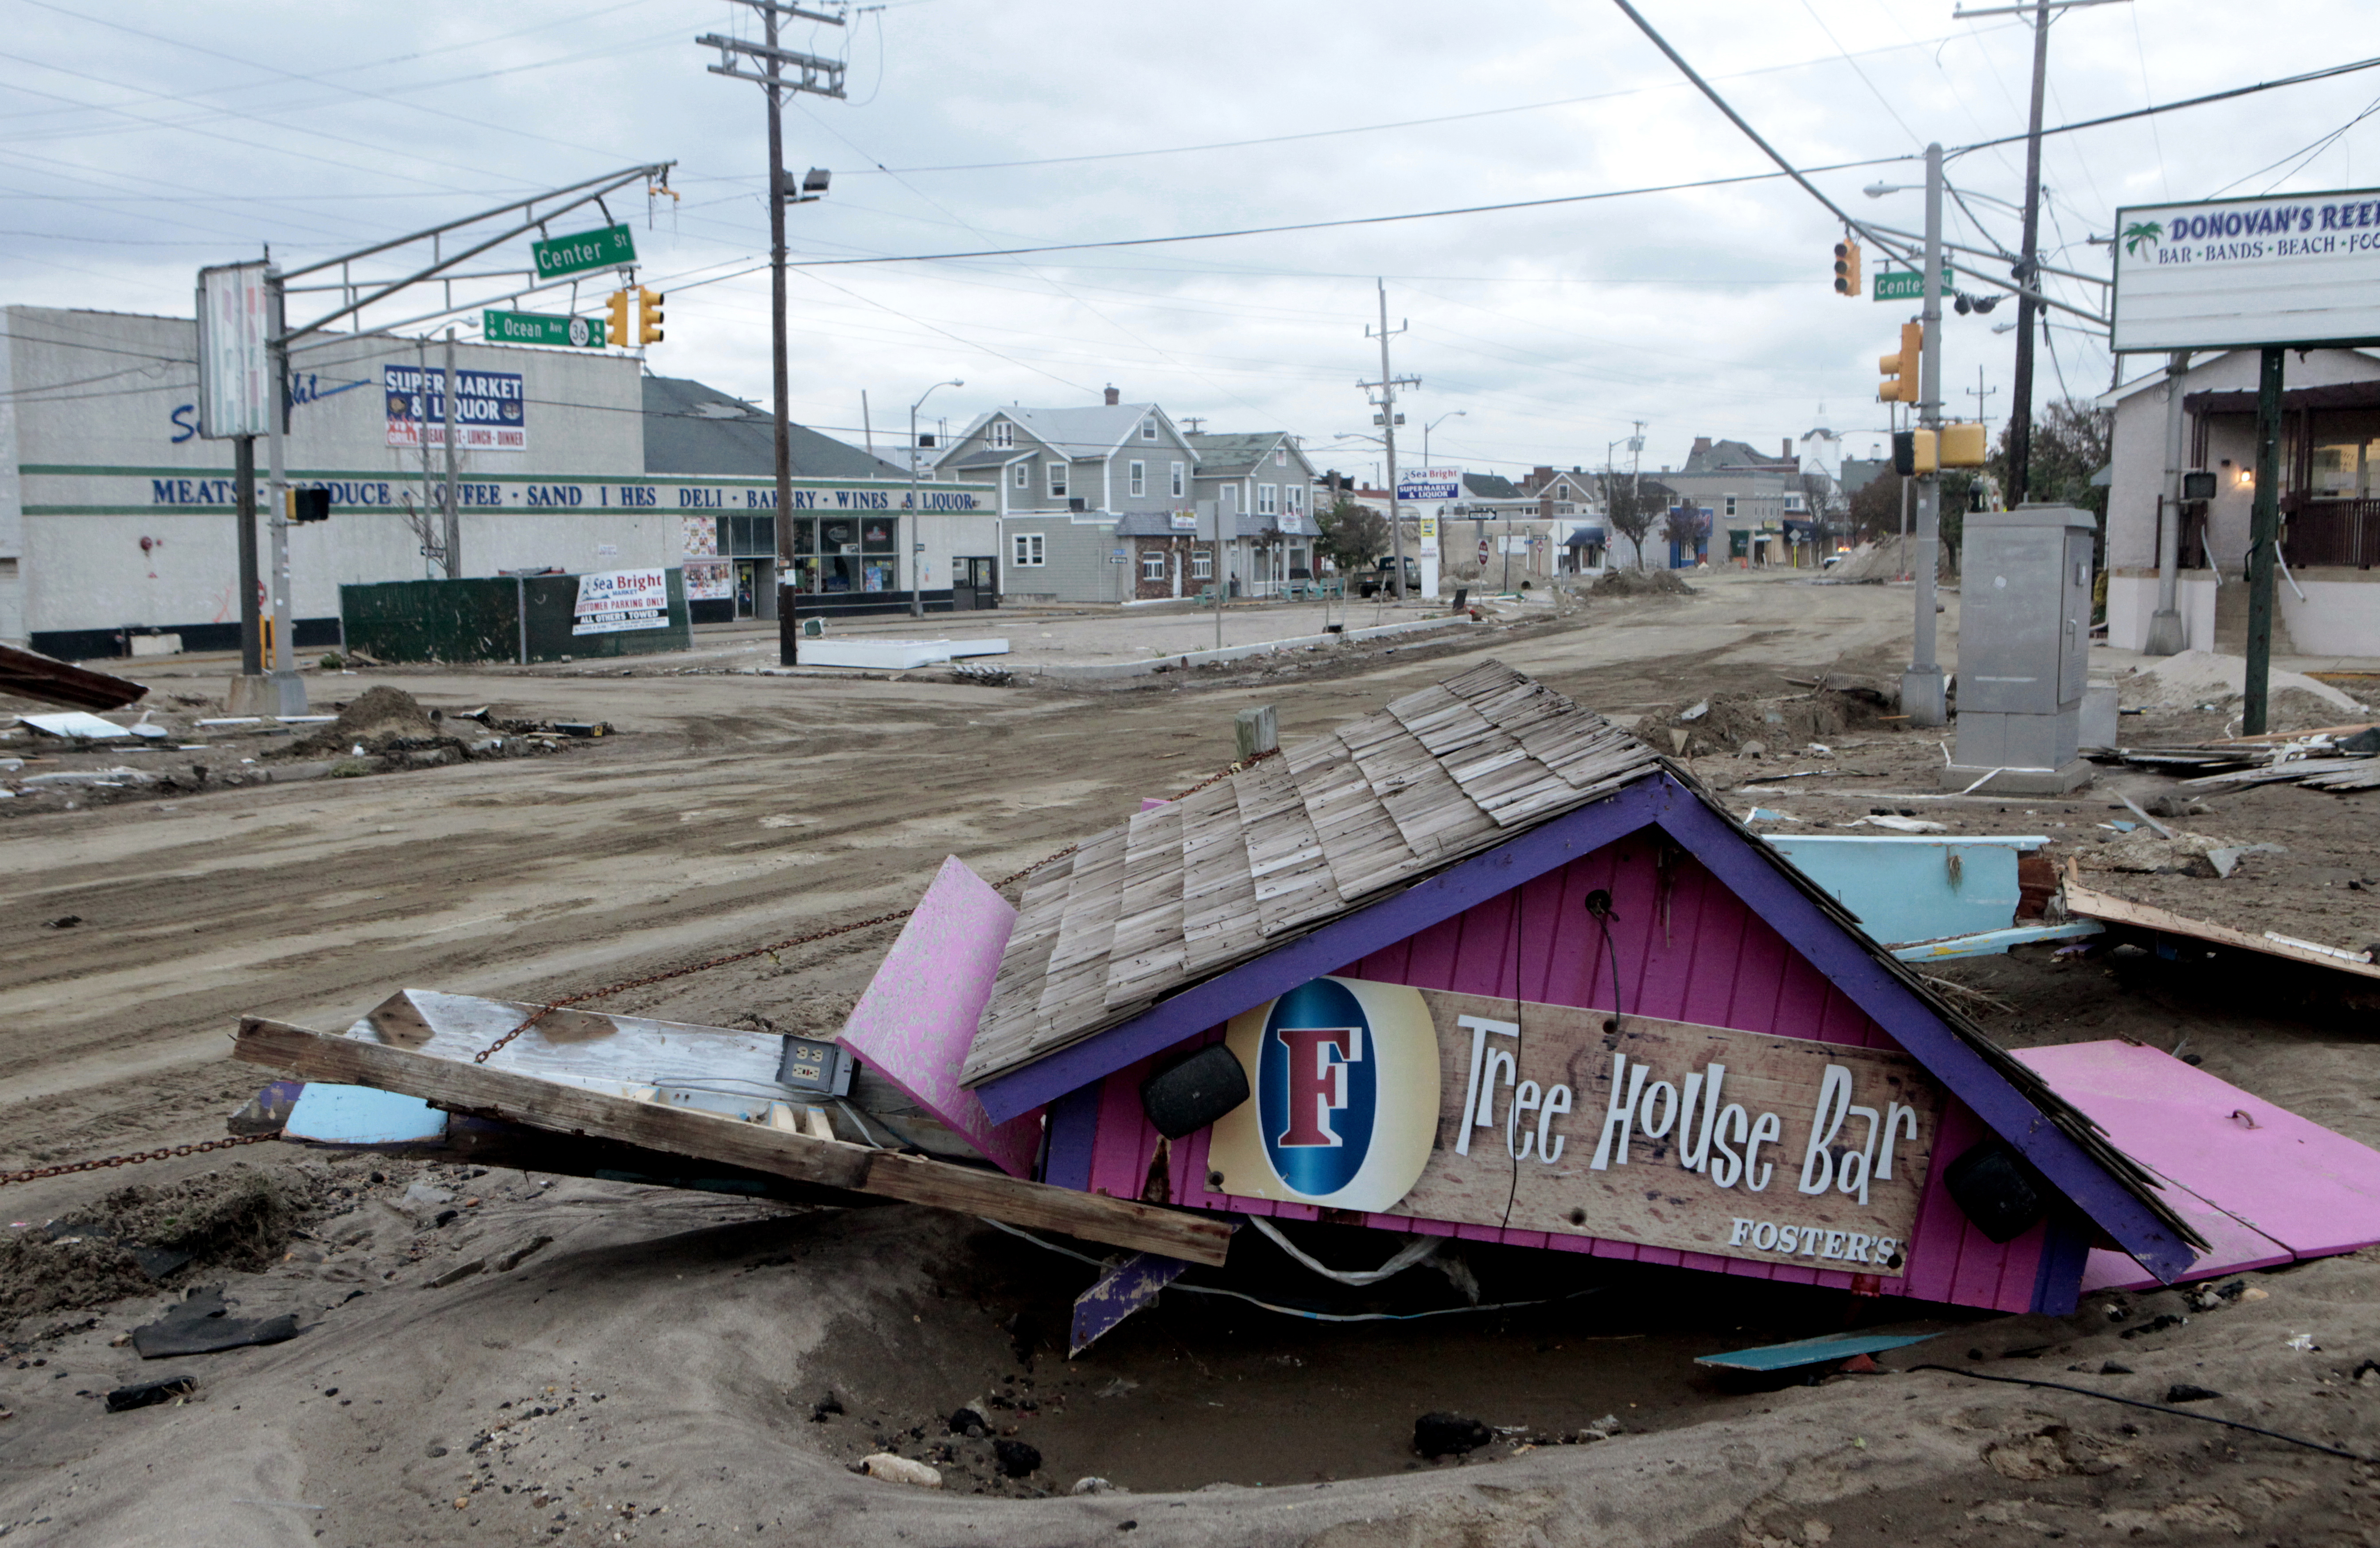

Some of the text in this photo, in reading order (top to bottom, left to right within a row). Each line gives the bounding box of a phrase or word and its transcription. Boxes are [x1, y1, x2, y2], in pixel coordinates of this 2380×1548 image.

[2169, 205, 2314, 242] DONOVAN'S
[539, 233, 627, 270] Center St
[2159, 246, 2192, 265] BAR
[2205, 241, 2263, 261] BANDS
[2277, 235, 2336, 256] BEACH
[1877, 278, 1924, 295] Cente
[489, 313, 600, 341] S Ocean Ave 36 N
[411, 396, 422, 417] &
[468, 430, 491, 445] LUNCH
[498, 431, 523, 446] DINNER
[1411, 469, 1457, 480] Sea Bright
[680, 488, 722, 508] DELI
[747, 490, 817, 508] BARY
[836, 491, 888, 509] WINES
[906, 492, 913, 508] &
[922, 492, 973, 512] LIQUOR
[593, 574, 661, 592] Sea Bright
[577, 597, 664, 613] CUSTOMER PARKING ONLY
[580, 616, 594, 624] ALL
[595, 612, 626, 623] OTHERS
[628, 610, 658, 619] TOWED
[1277, 1027, 1362, 1148] F
[1455, 1014, 1917, 1205] Tree House Bar
[1728, 1217, 1898, 1264] FOSTER'S
